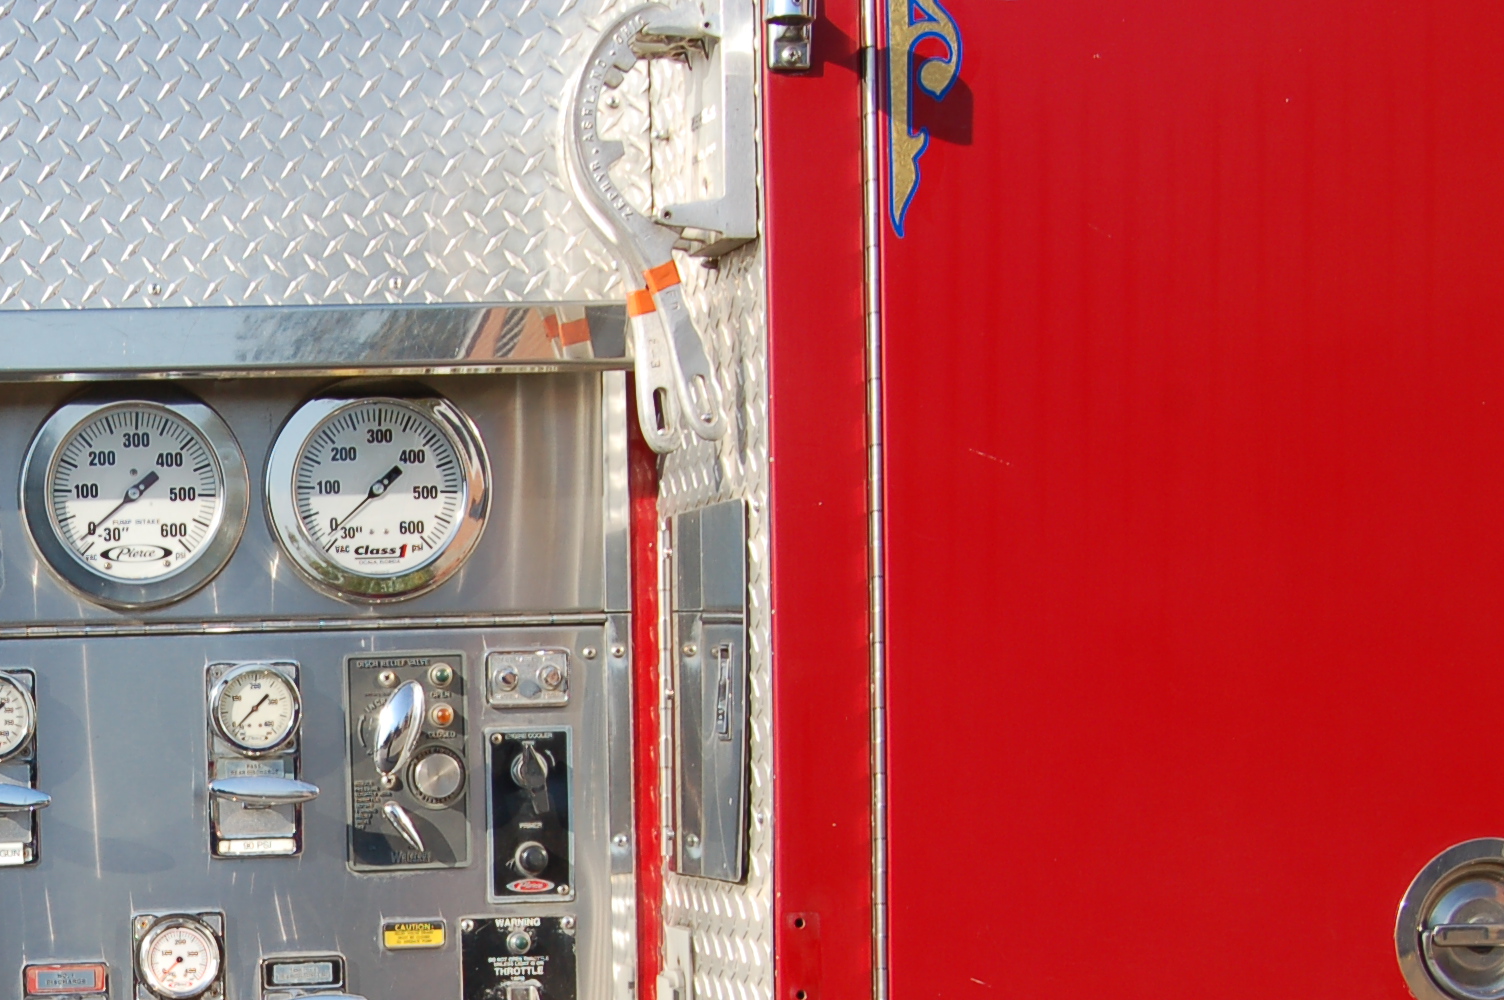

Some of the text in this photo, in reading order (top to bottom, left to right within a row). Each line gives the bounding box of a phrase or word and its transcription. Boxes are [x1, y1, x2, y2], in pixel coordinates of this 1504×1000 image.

[590, 161, 634, 221] ZEPHYR
[123, 432, 150, 448] 300
[367, 429, 393, 444] 300
[88, 451, 116, 466] 200
[156, 452, 183, 467] 400
[331, 447, 357, 462] 200
[399, 450, 425, 464] 400
[74, 484, 99, 499] 100
[170, 487, 196, 501] 500
[317, 480, 340, 495] 100
[413, 486, 438, 500] 500
[160, 523, 187, 537] 600
[330, 518, 338, 531] 0
[400, 521, 425, 535] 600
[412, 545, 424, 553] psi
[176, 552, 187, 561] psi
[257, 841, 272, 849] PSI
[0, 849, 21, 858] GUN
[494, 918, 541, 927] WARNING
[494, 967, 544, 976] THROTTLE
